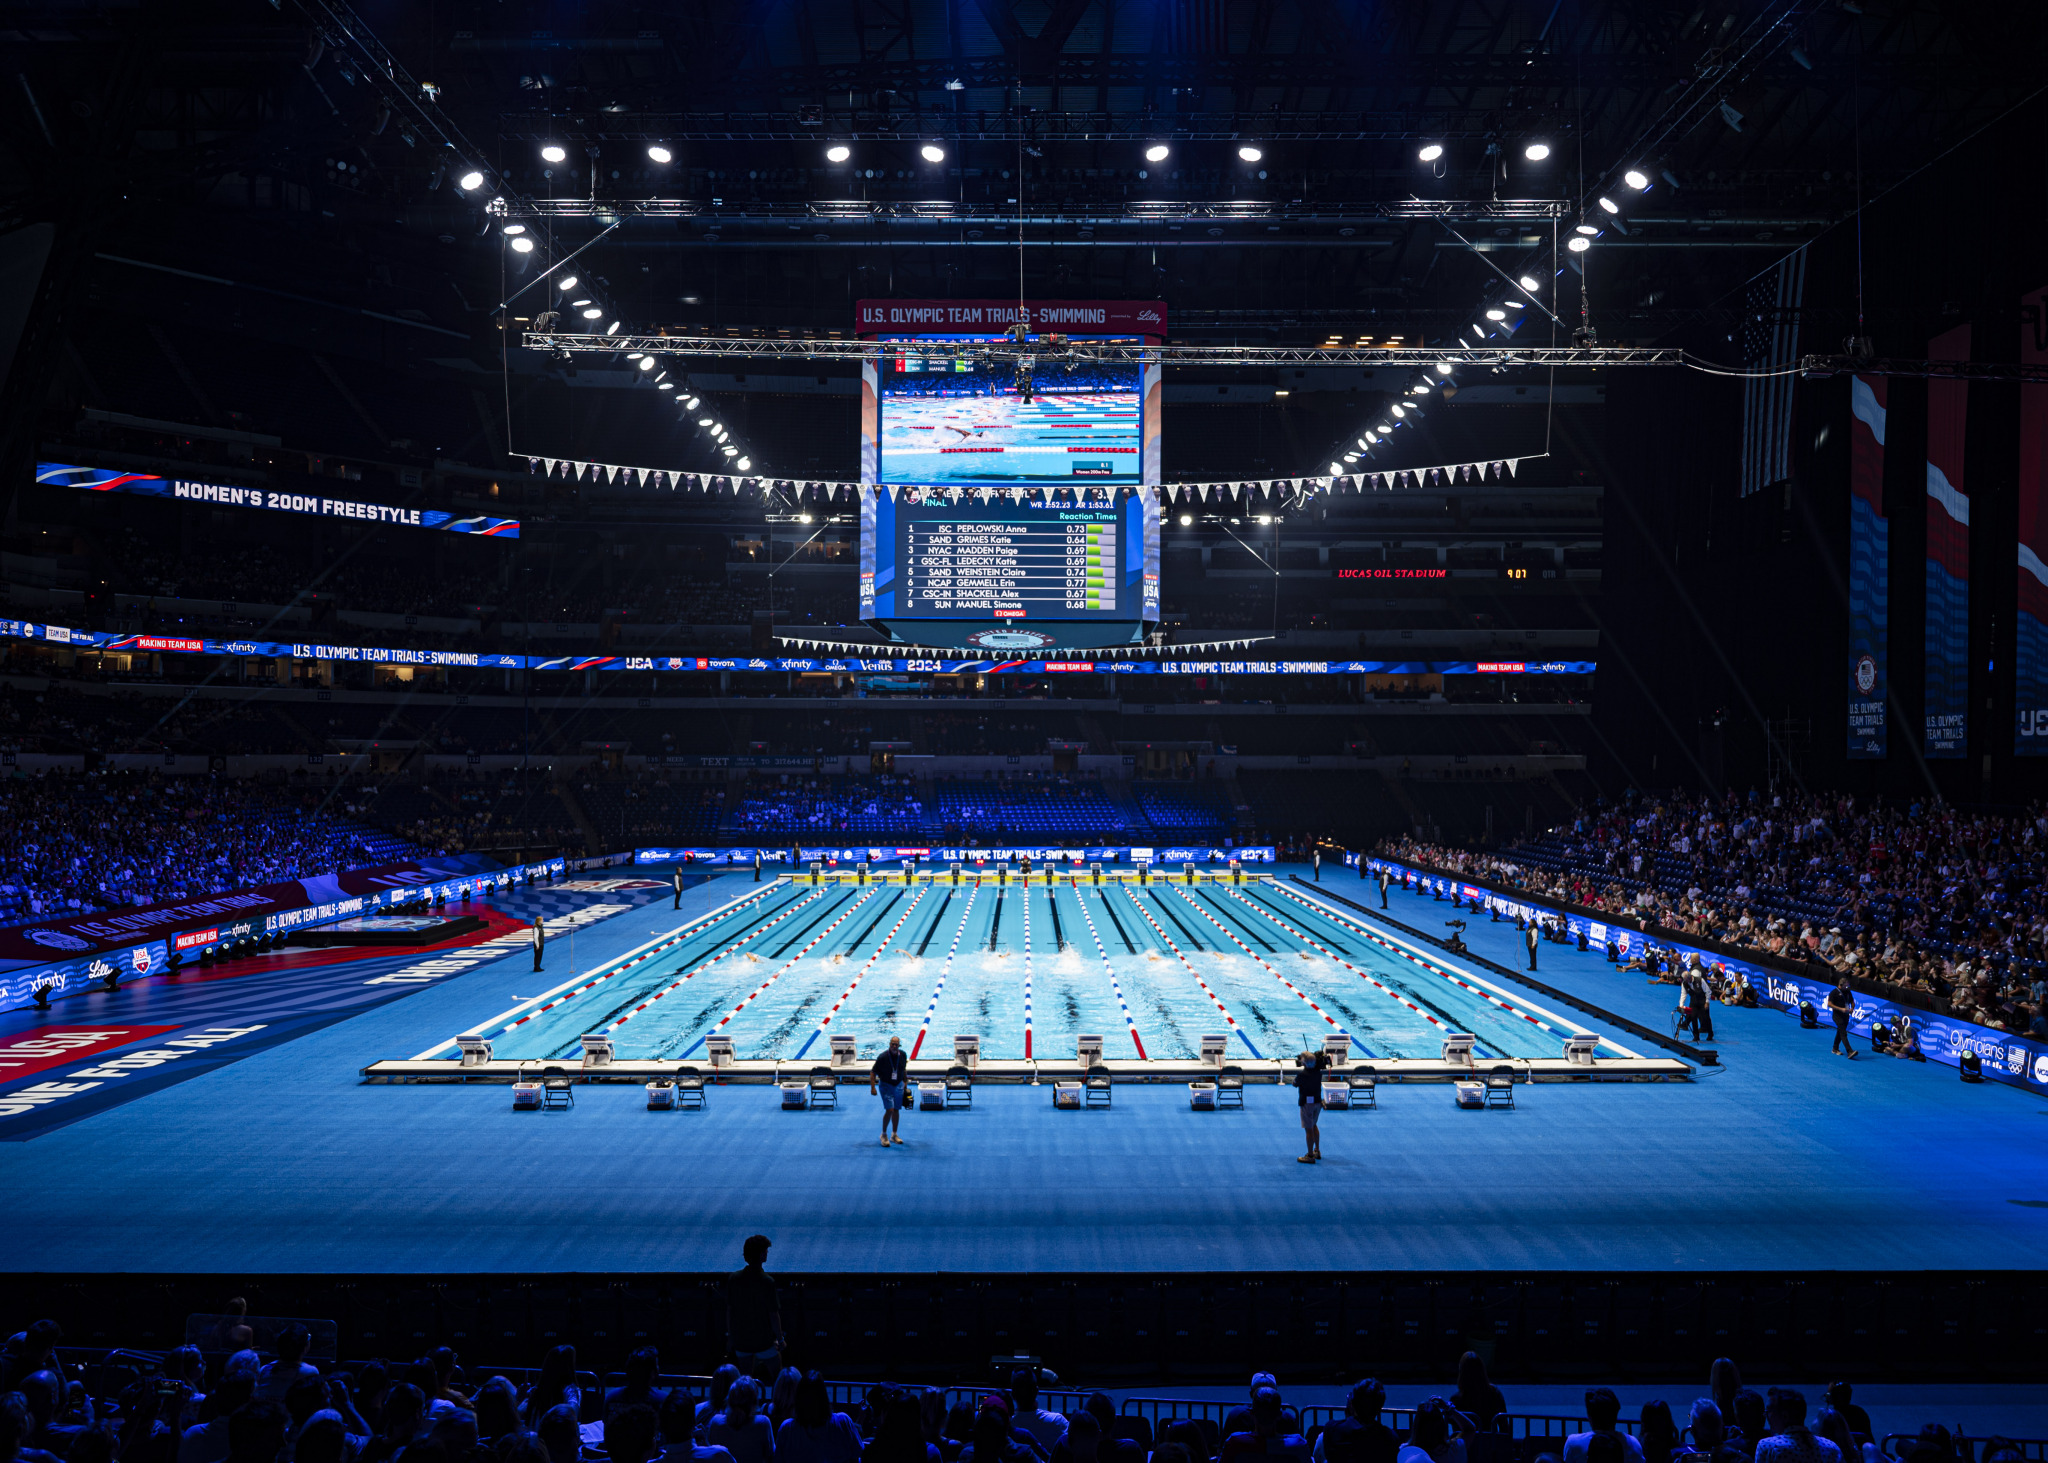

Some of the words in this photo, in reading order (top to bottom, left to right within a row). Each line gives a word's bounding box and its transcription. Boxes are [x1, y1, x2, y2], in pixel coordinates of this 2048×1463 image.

[863, 308, 887, 323] U.S.
[891, 308, 944, 323] OLYMPIC
[948, 308, 982, 323] TEAM
[1137, 310, 1161, 324] Lilly
[268, 493, 318, 514] 200M
[322, 498, 421, 525] FREESTYLE
[1060, 512, 1094, 520] Reaction
[1096, 512, 1117, 520] Times
[908, 525, 914, 533] 1
[939, 525, 952, 533] ISC
[956, 525, 1004, 533] PEPLOWSKI
[1006, 525, 1027, 533] Anna
[1066, 525, 1084, 533] 0.73
[908, 536, 914, 544] 2
[929, 536, 952, 544] SAND
[956, 536, 988, 544] GRIMES
[990, 536, 1012, 544] Katie
[1066, 536, 1084, 544] 0.64
[908, 546, 914, 555] 3
[928, 546, 952, 555] NYAC
[956, 546, 994, 555] MADDEN
[996, 546, 1018, 556] Paige
[1066, 546, 1084, 555] 0.69
[908, 558, 914, 566] 4
[921, 558, 952, 566] GSC-FL
[956, 558, 994, 566] LEDECKY
[996, 558, 1016, 566] Katie
[1066, 558, 1084, 566] 0.69
[908, 568, 914, 577] 5
[929, 568, 952, 577] SAND
[956, 568, 1000, 577] WEINSTEIN
[1002, 568, 1026, 577] Claire
[1066, 568, 1084, 577] 0.74
[1338, 570, 1372, 578] LUCAS
[1374, 570, 1392, 578] OIL
[1394, 570, 1446, 578] STADIUM
[908, 579, 914, 588] 6
[928, 579, 952, 588] NCAP
[956, 579, 998, 588] GEMMELL
[1000, 579, 1016, 588] Erin
[1066, 579, 1084, 588] 0.77
[860, 584, 875, 596] USA
[908, 590, 914, 598] 7
[922, 590, 952, 598] CSC-IN
[956, 590, 999, 598] SHACKELL
[1000, 590, 1019, 598] Alex
[1066, 590, 1084, 598] 0.67
[1144, 585, 1159, 598] USA
[908, 601, 914, 609] 8
[935, 601, 952, 609] SUN
[956, 601, 992, 609] MANUEL
[994, 601, 1022, 609] Simone
[1066, 601, 1084, 609] 0.68
[139, 638, 166, 648] MAKING
[168, 640, 186, 649] TEAM
[187, 641, 201, 650] USA
[226, 642, 257, 654] xfinity
[293, 644, 313, 658] U.S.
[316, 646, 358, 660] OLYMPIC
[362, 648, 388, 662] TEAM
[500, 656, 516, 668] Lilly
[749, 658, 768, 670] Lilly
[782, 660, 812, 670] xfinity
[860, 660, 893, 671] Venus
[1110, 662, 1134, 672] xfinity
[1162, 662, 1178, 673] U.S.
[1181, 662, 1218, 673] OLYMPIC
[1220, 662, 1244, 673] TEAM
[1348, 662, 1366, 672] Lilly
[1542, 662, 1566, 672] xfinity
[1860, 702, 1884, 713] OLYMPIC
[1850, 716, 1864, 726] TEAM
[1865, 714, 1884, 726] TRIALS
[1938, 714, 1964, 726] OLYMPIC
[1926, 729, 1942, 740] TEAM
[1943, 728, 1964, 740] TRIALS
[700, 758, 730, 766] TEXT
[943, 850, 958, 860] U.S.
[1165, 850, 1193, 860] xfinity
[266, 916, 278, 930] U.S.
[278, 910, 302, 928] OLYMPIC
[302, 907, 318, 922] TEAM
[232, 922, 251, 938] xfinity
[178, 936, 196, 948] MAKING
[196, 934, 208, 944] TEAM
[208, 932, 217, 942] USA
[1768, 976, 1799, 1006] Venus
[164, 1024, 269, 1048] ALL
[1950, 1030, 2004, 1060] Olympians
[66, 1050, 198, 1078] FOR
